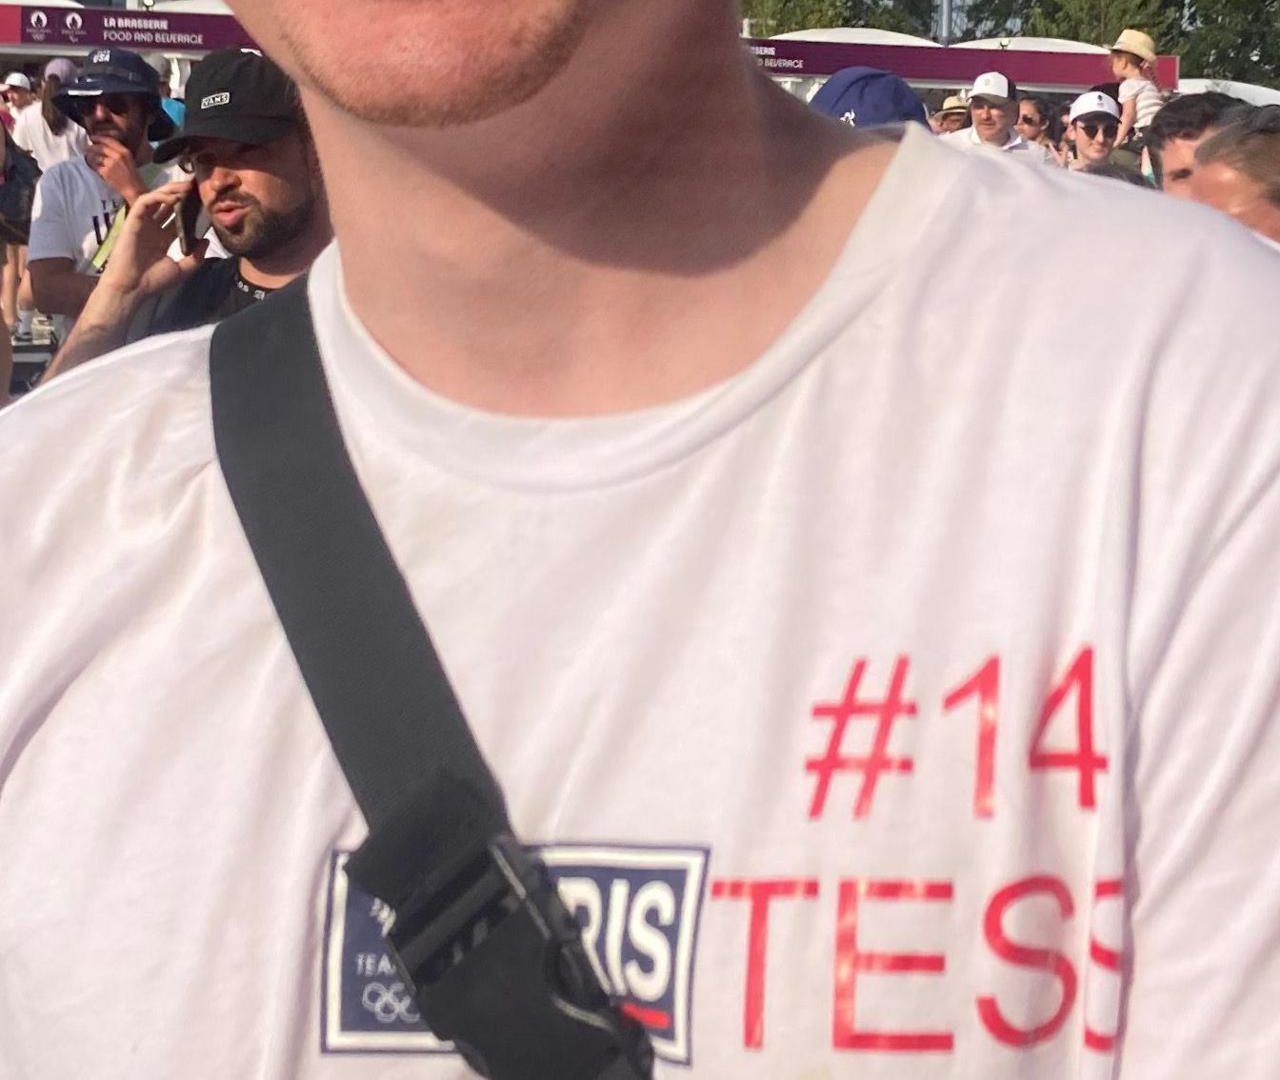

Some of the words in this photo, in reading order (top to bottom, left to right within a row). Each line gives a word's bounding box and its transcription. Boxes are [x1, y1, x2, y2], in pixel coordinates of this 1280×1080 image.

[103, 17, 116, 28] LA
[103, 30, 133, 41] FOOD
[134, 31, 153, 42] AND
[155, 32, 203, 44] BEVERAGE
[805, 645, 1109, 820] #14
[558, 876, 677, 1002] RIS
[356, 951, 397, 977] TEA
